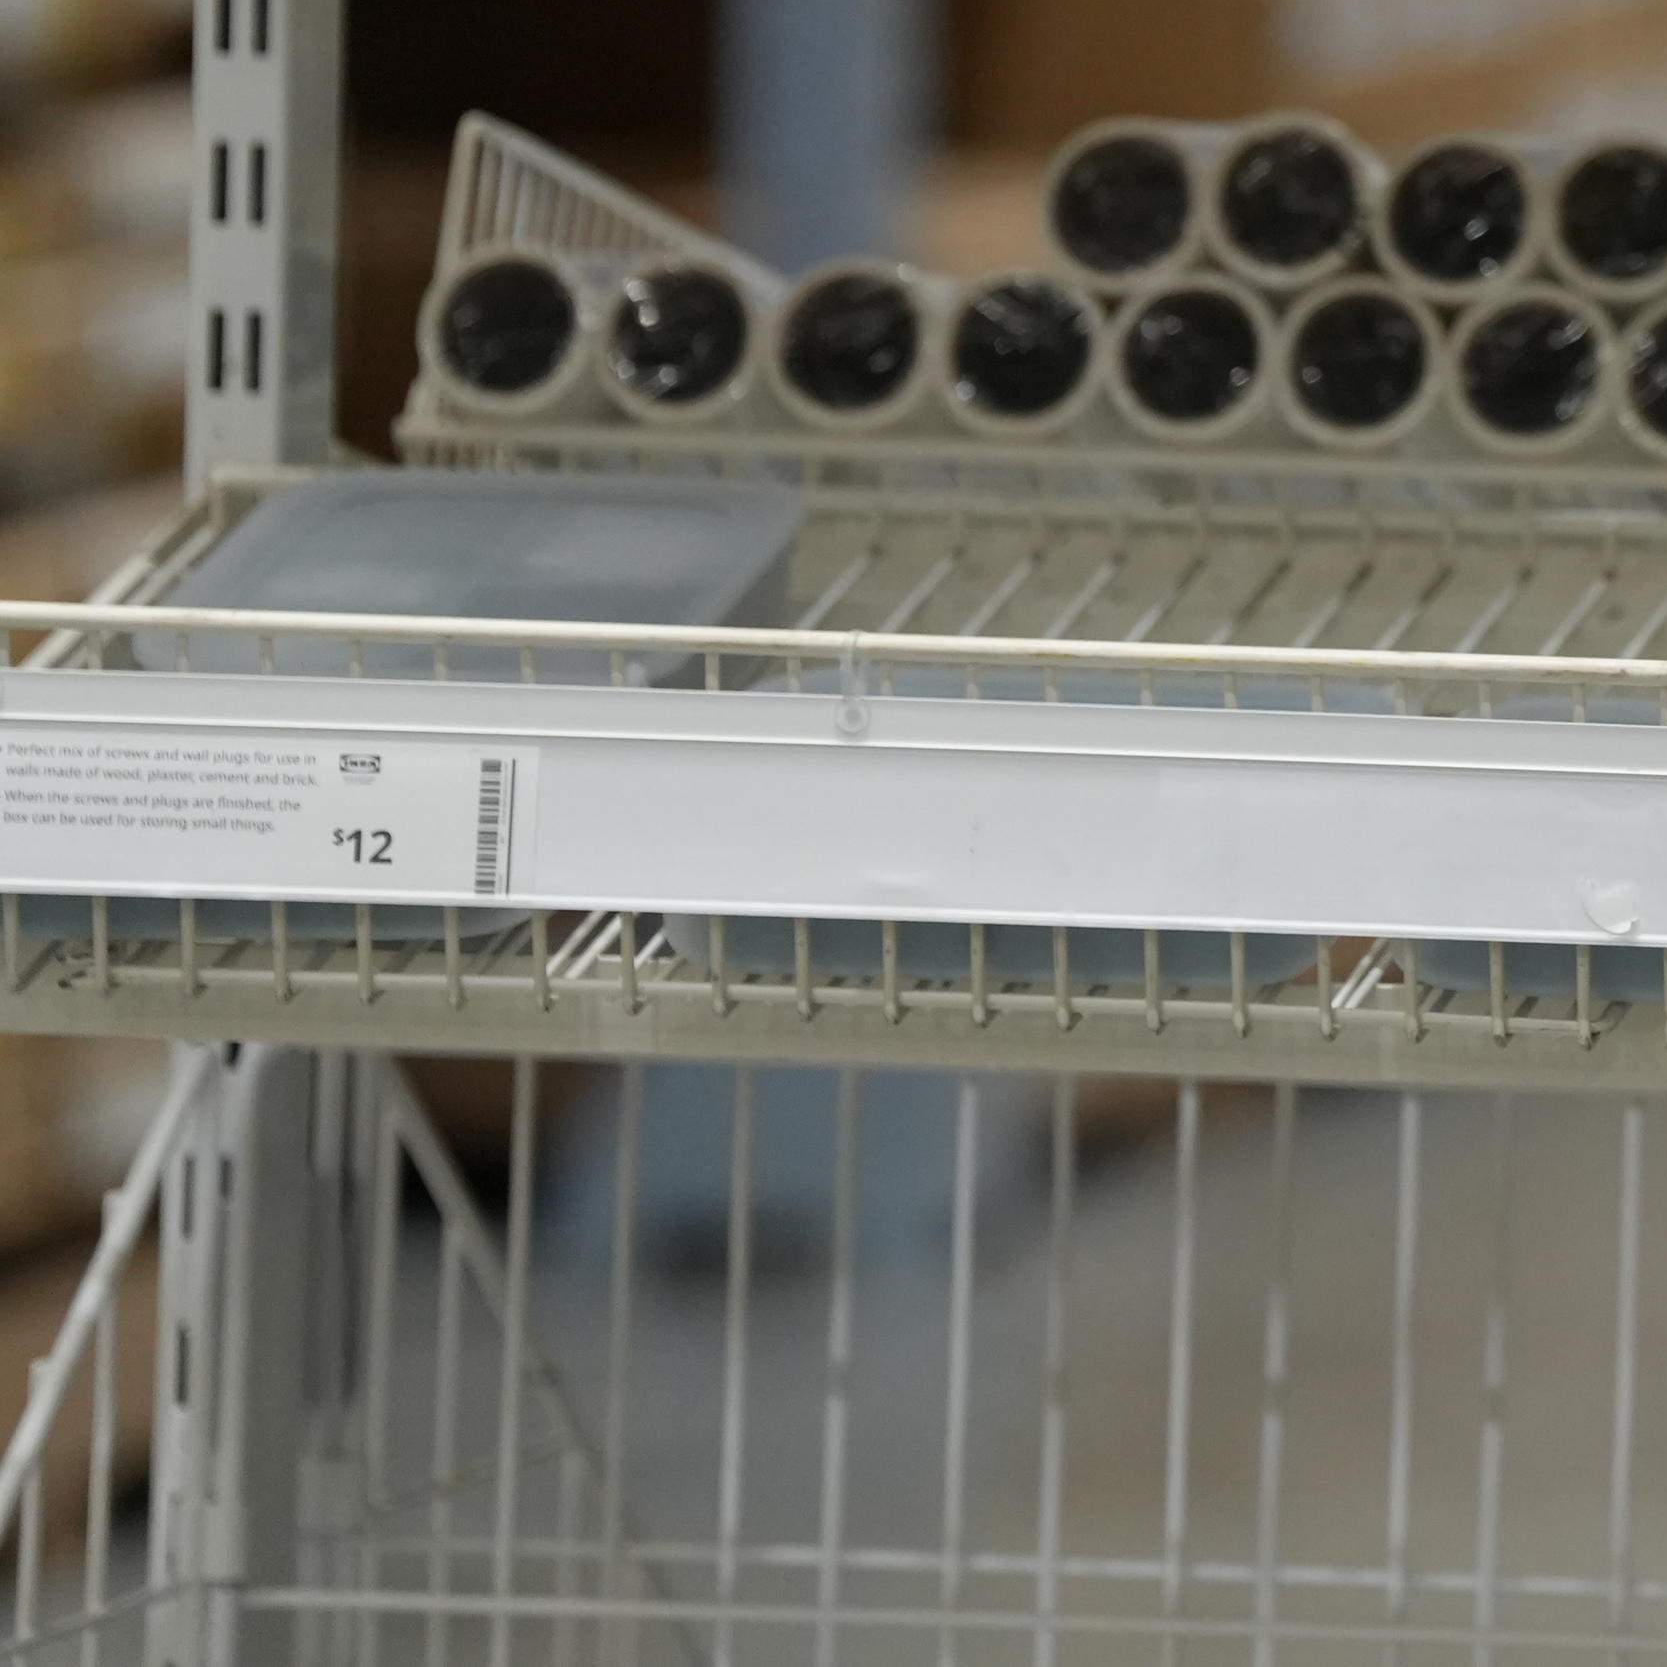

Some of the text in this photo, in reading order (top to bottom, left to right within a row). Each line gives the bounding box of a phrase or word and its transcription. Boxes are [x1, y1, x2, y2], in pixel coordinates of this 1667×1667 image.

[7, 742, 317, 766] Perfect mix of screws and wall plugs for use in
[5, 763, 40, 777] walls
[43, 766, 82, 779] made
[85, 766, 100, 779] of
[199, 771, 250, 784] cement
[253, 772, 279, 785] and
[4, 789, 43, 803] When
[47, 790, 70, 804] the
[73, 793, 119, 805] screws
[122, 793, 148, 807] and
[152, 794, 188, 811] plugs
[192, 797, 215, 809] are
[278, 799, 302, 812] the
[3, 811, 28, 824] box
[31, 814, 56, 825] can
[59, 812, 77, 825] be
[80, 813, 113, 826] used
[116, 814, 136, 827] for
[140, 815, 188, 832] storing
[191, 817, 228, 831] small
[332, 827, 393, 865] $12
